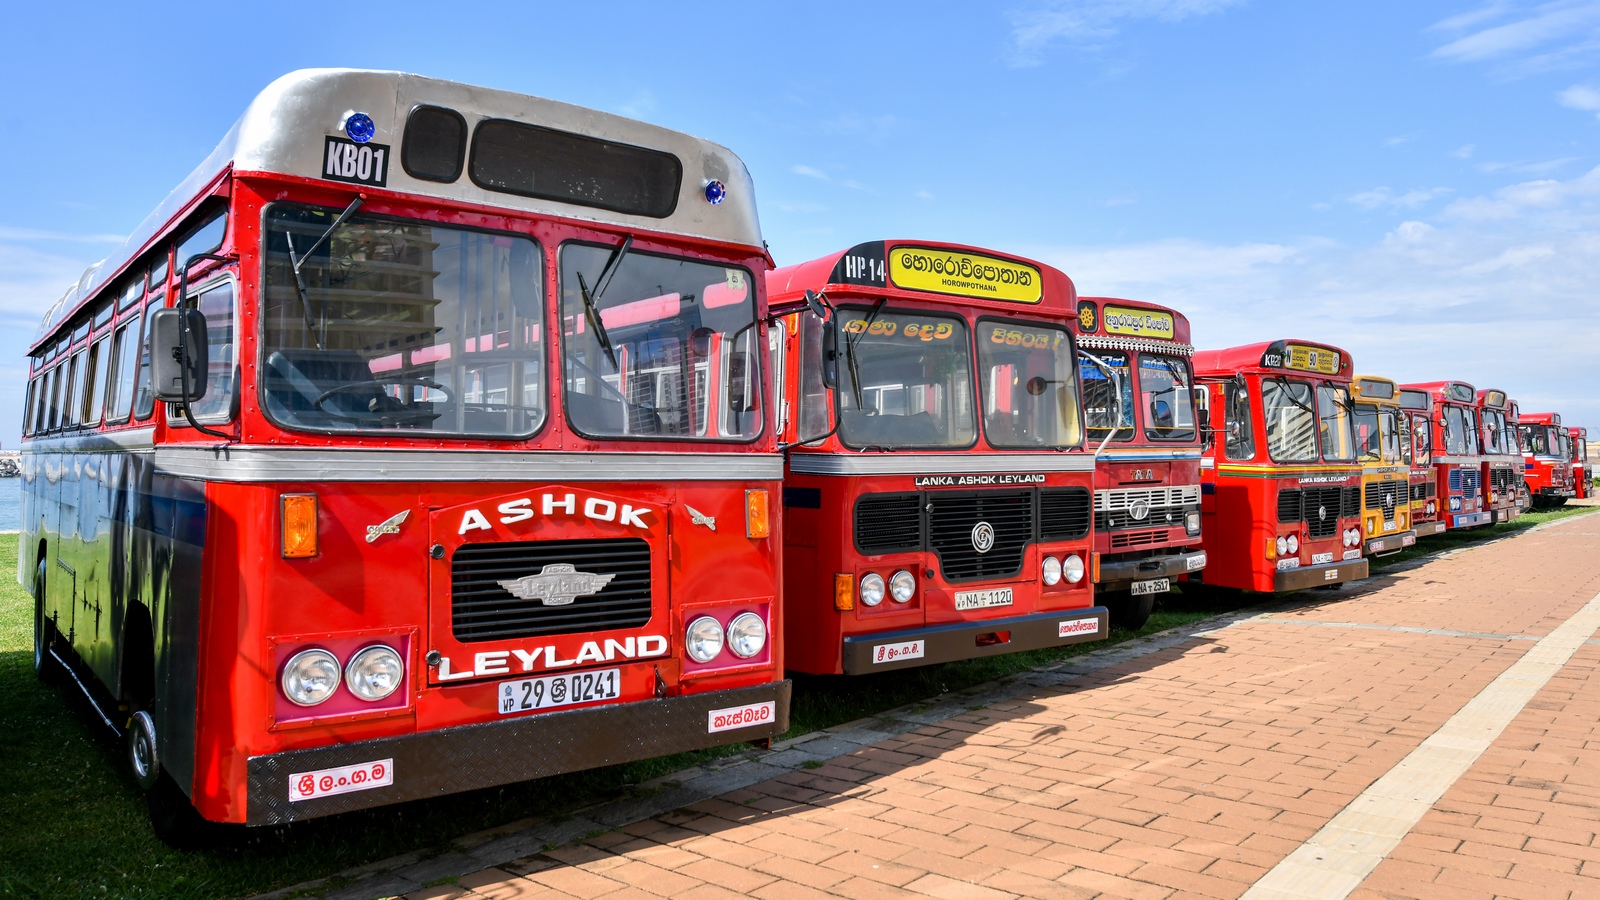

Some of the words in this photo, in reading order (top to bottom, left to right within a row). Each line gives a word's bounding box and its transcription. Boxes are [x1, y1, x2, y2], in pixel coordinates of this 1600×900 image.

[326, 141, 385, 182] KB01
[901, 253, 1032, 287] හොරොව්පොතාන
[941, 278, 998, 292] HOROWPOTHANA
[1309, 353, 1317, 366] 90
[915, 476, 954, 486] LANKA
[958, 475, 996, 485] ASHOK
[999, 474, 1046, 483] LEYLAND
[1130, 469, 1153, 480] TATA
[457, 493, 652, 536] ASHOK
[524, 575, 592, 599] Leyland
[966, 593, 979, 607] NA
[988, 590, 1012, 605] 1120
[437, 634, 668, 681] LEYLAND
[502, 697, 515, 712] WP
[521, 679, 545, 709] 29
[571, 671, 616, 702] 0241
[713, 705, 770, 728] කැස්බෑව
